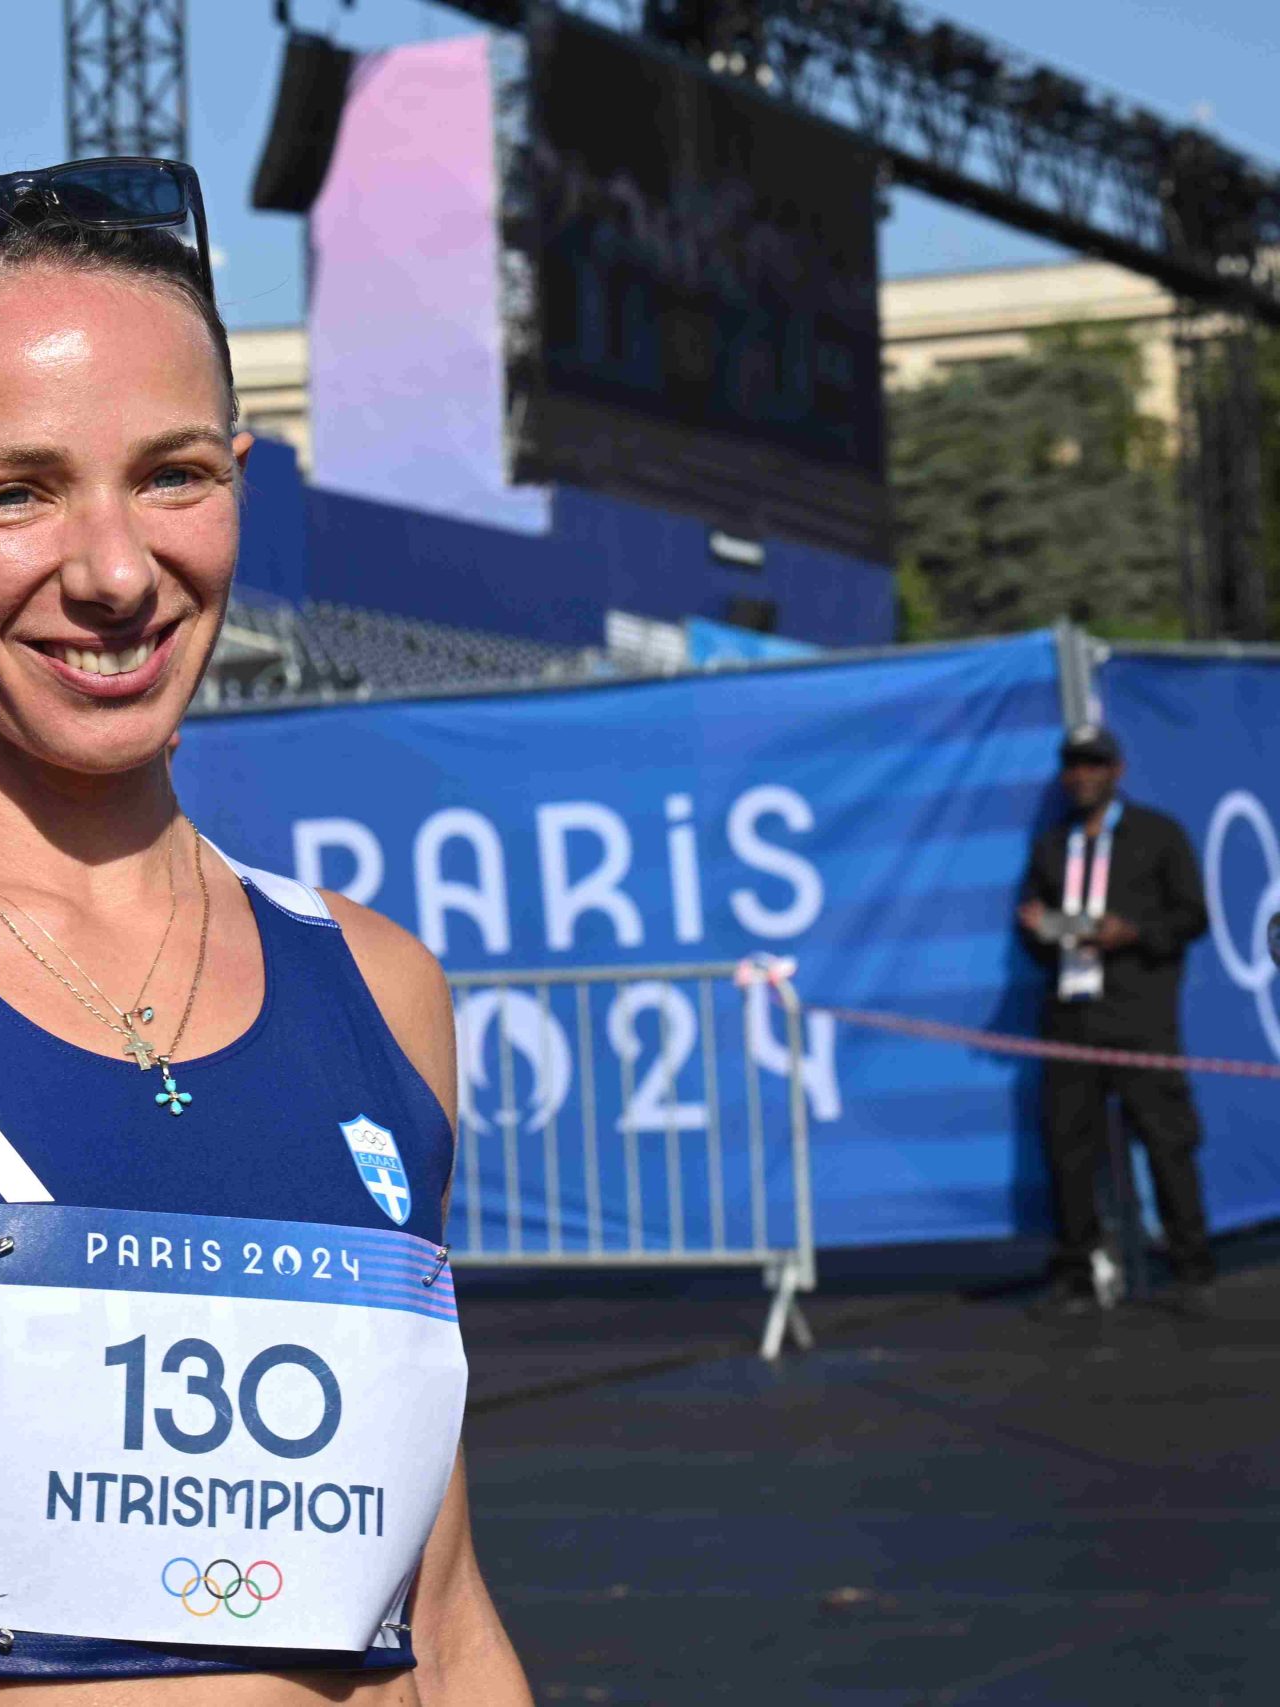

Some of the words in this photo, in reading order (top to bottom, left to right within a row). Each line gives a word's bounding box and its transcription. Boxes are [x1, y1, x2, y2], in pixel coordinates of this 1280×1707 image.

[458, 966, 841, 1132] 024
[243, 1243, 360, 1281] 2024
[104, 1334, 342, 1459] 130
[46, 1470, 384, 1536] NTRISMPIOTI
